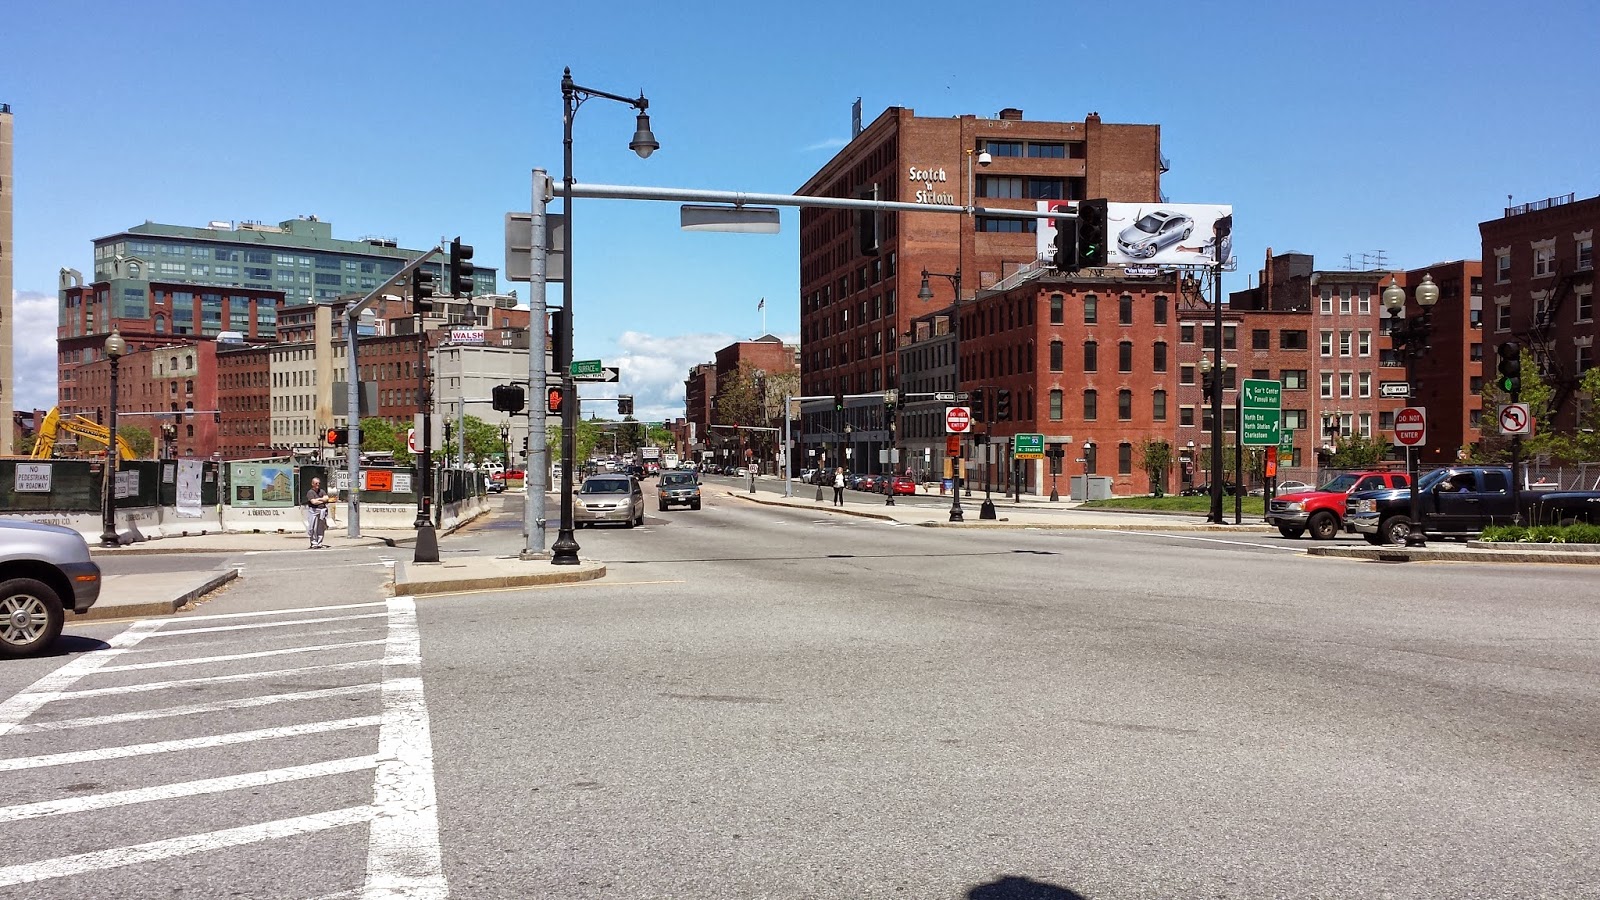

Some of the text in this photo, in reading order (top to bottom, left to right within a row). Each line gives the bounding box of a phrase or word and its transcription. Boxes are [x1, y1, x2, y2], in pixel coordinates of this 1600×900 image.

[909, 166, 947, 182] Scotch
[916, 190, 954, 205] Sirloin
[578, 365, 596, 373] SURFACE
[26, 482, 48, 490] ROADWAY
